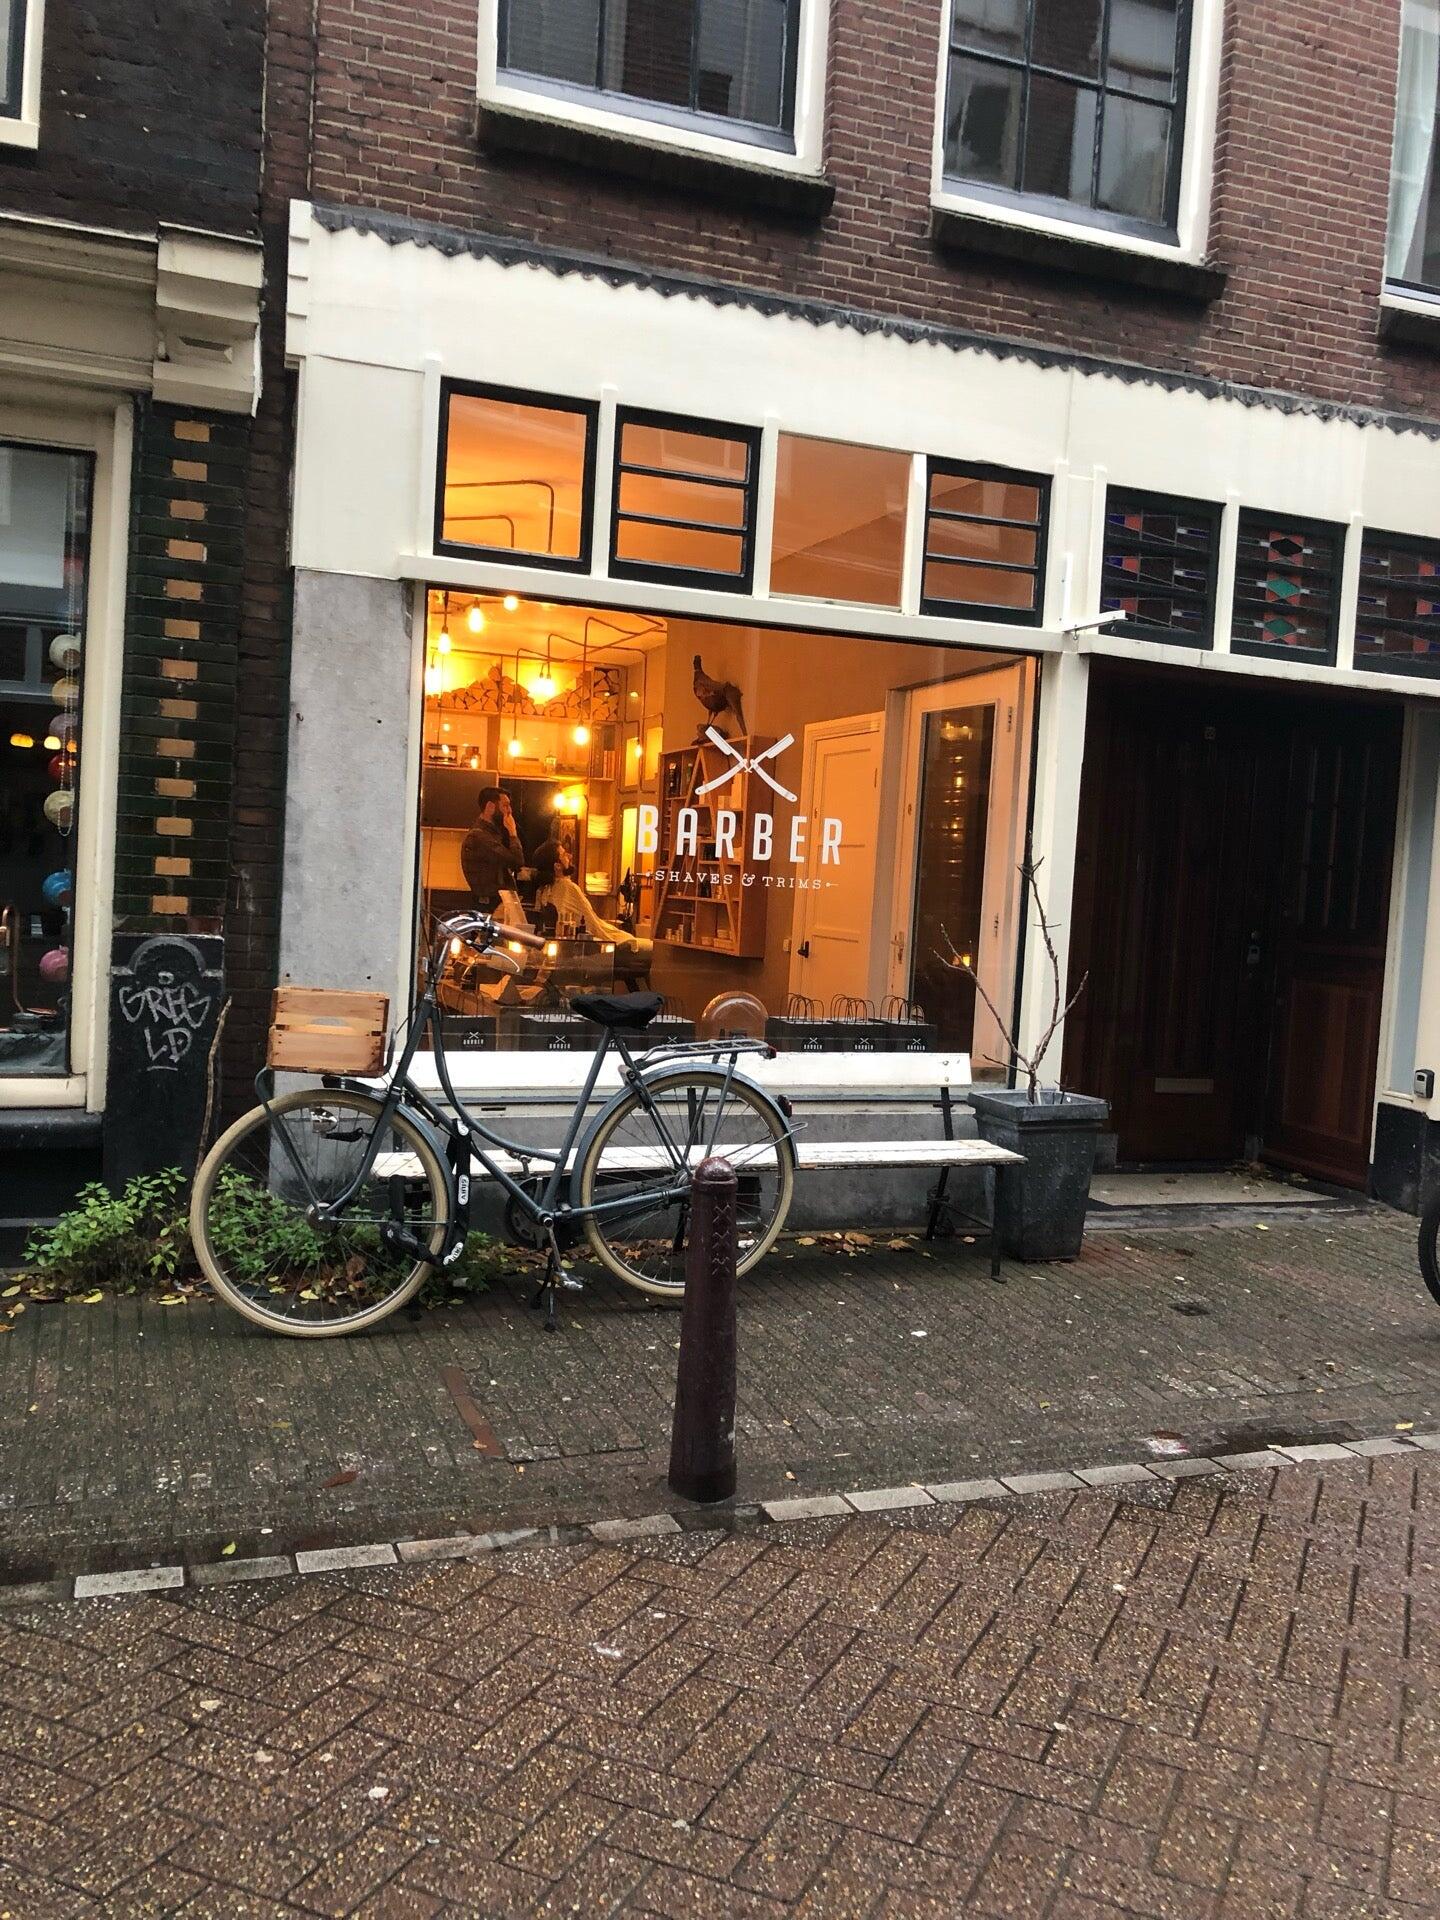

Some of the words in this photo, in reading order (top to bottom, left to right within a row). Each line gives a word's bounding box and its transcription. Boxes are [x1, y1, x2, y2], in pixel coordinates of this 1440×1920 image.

[637, 804, 842, 865] BARBER
[654, 870, 734, 885] SHAVES
[741, 873, 756, 887] &
[762, 876, 822, 890] TRIMS
